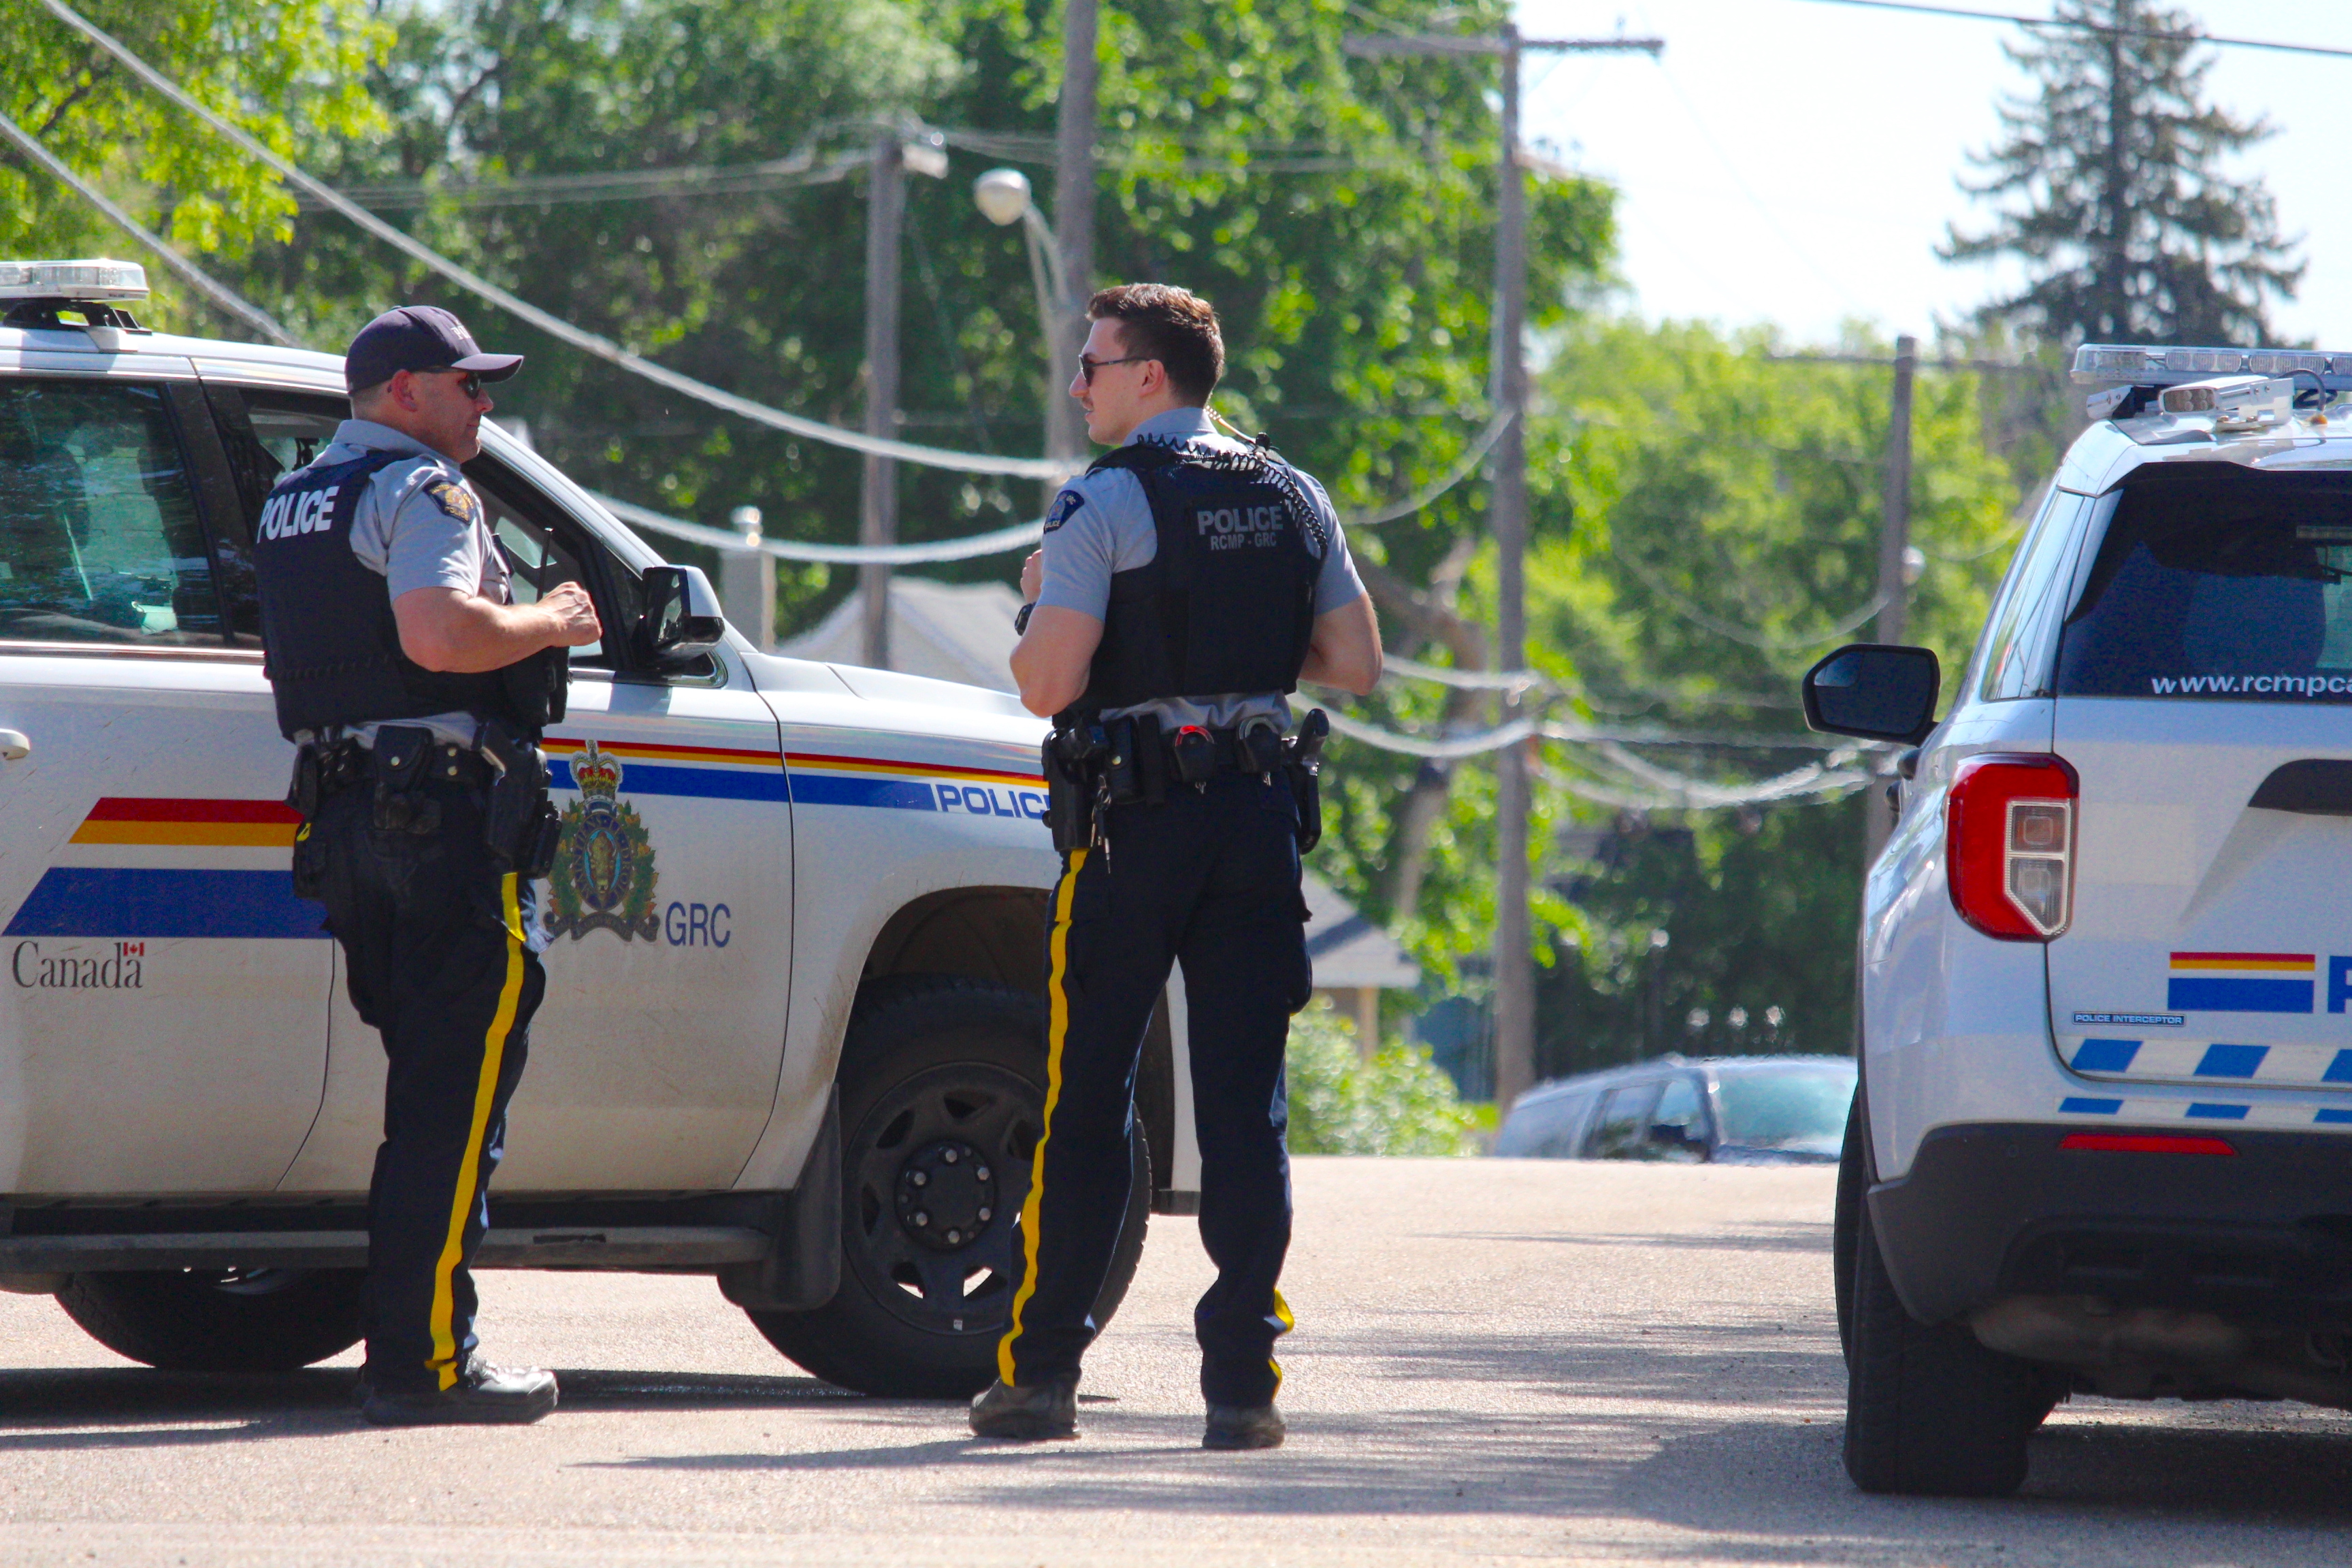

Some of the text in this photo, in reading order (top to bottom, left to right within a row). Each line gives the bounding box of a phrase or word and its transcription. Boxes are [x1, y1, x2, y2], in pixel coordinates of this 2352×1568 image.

[257, 486, 340, 544] POLICE
[1198, 506, 1284, 535] POLICE
[1211, 532, 1277, 551] RCMP GRC
[935, 784, 1051, 820] POLIC
[666, 902, 731, 947] GRC
[12, 941, 143, 988] Canada
[2076, 1014, 2182, 1024] POLICE INTERCEPTOR
